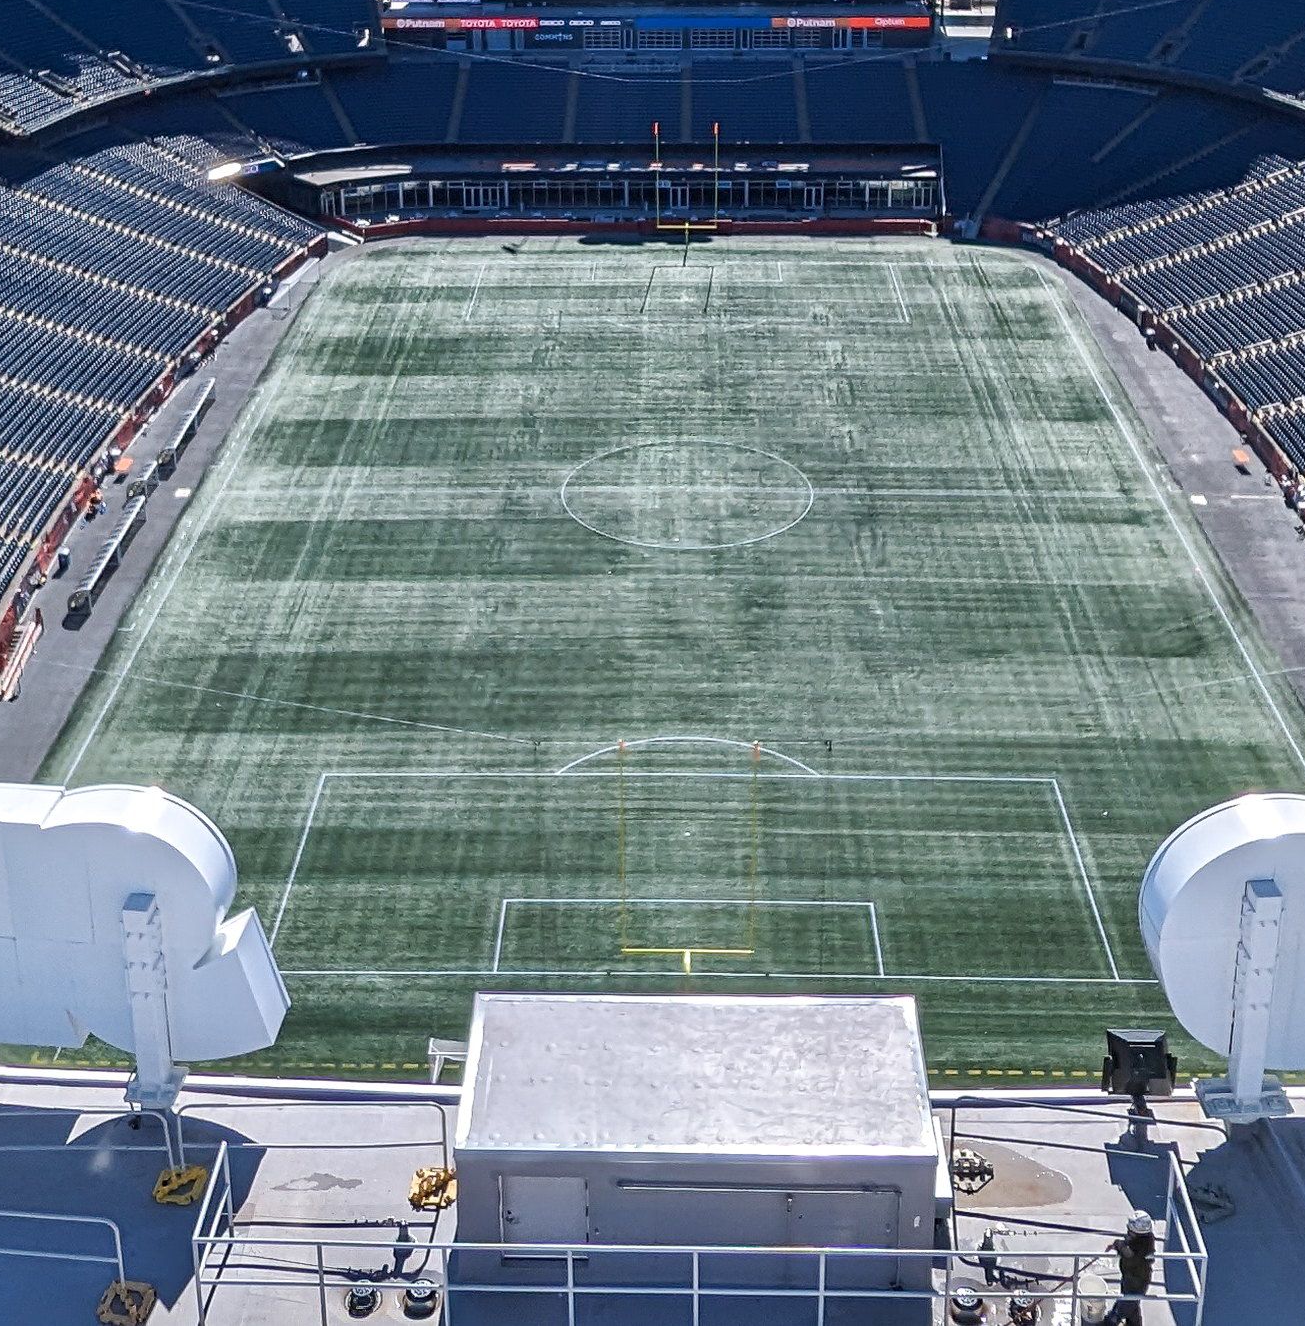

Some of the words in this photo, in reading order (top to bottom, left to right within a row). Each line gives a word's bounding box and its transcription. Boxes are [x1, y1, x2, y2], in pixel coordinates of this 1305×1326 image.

[405, 19, 445, 28] Putnam
[460, 19, 496, 28] TOYOTA
[500, 19, 537, 28] TOYOTA
[796, 18, 836, 27] Putnam
[874, 18, 905, 26] Optum
